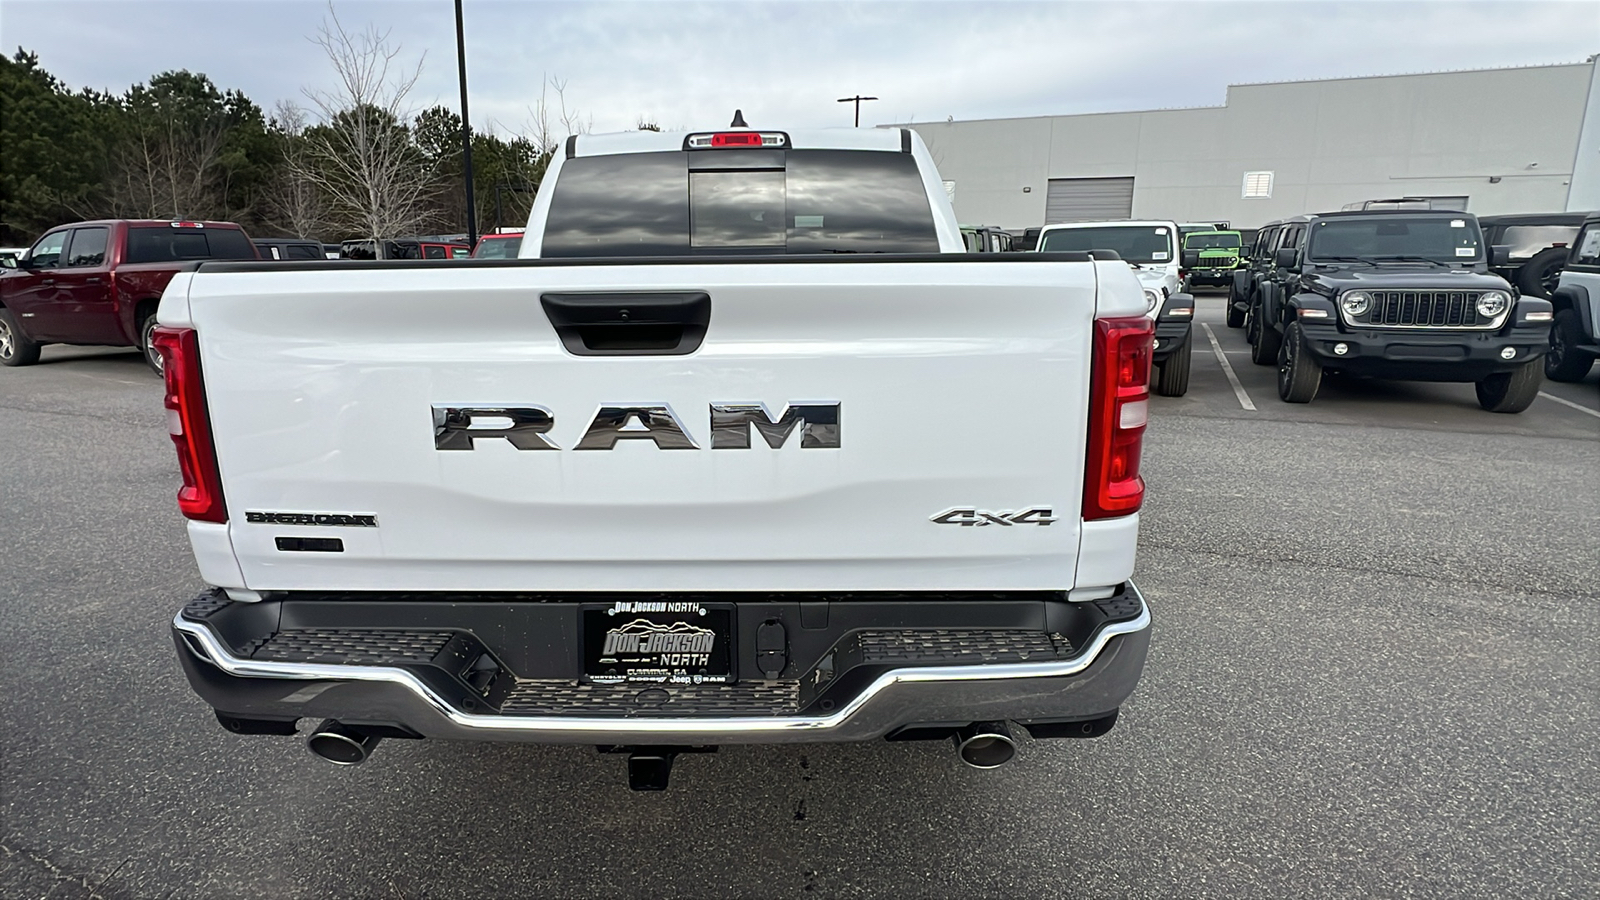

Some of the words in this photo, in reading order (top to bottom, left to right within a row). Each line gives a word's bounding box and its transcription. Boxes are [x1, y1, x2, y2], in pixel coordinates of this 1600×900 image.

[430, 401, 842, 450] RAM
[667, 602, 700, 612] NORTH
[639, 632, 716, 654] JACKSON
[660, 653, 709, 666] NORTH
[669, 674, 692, 685] Jeep
